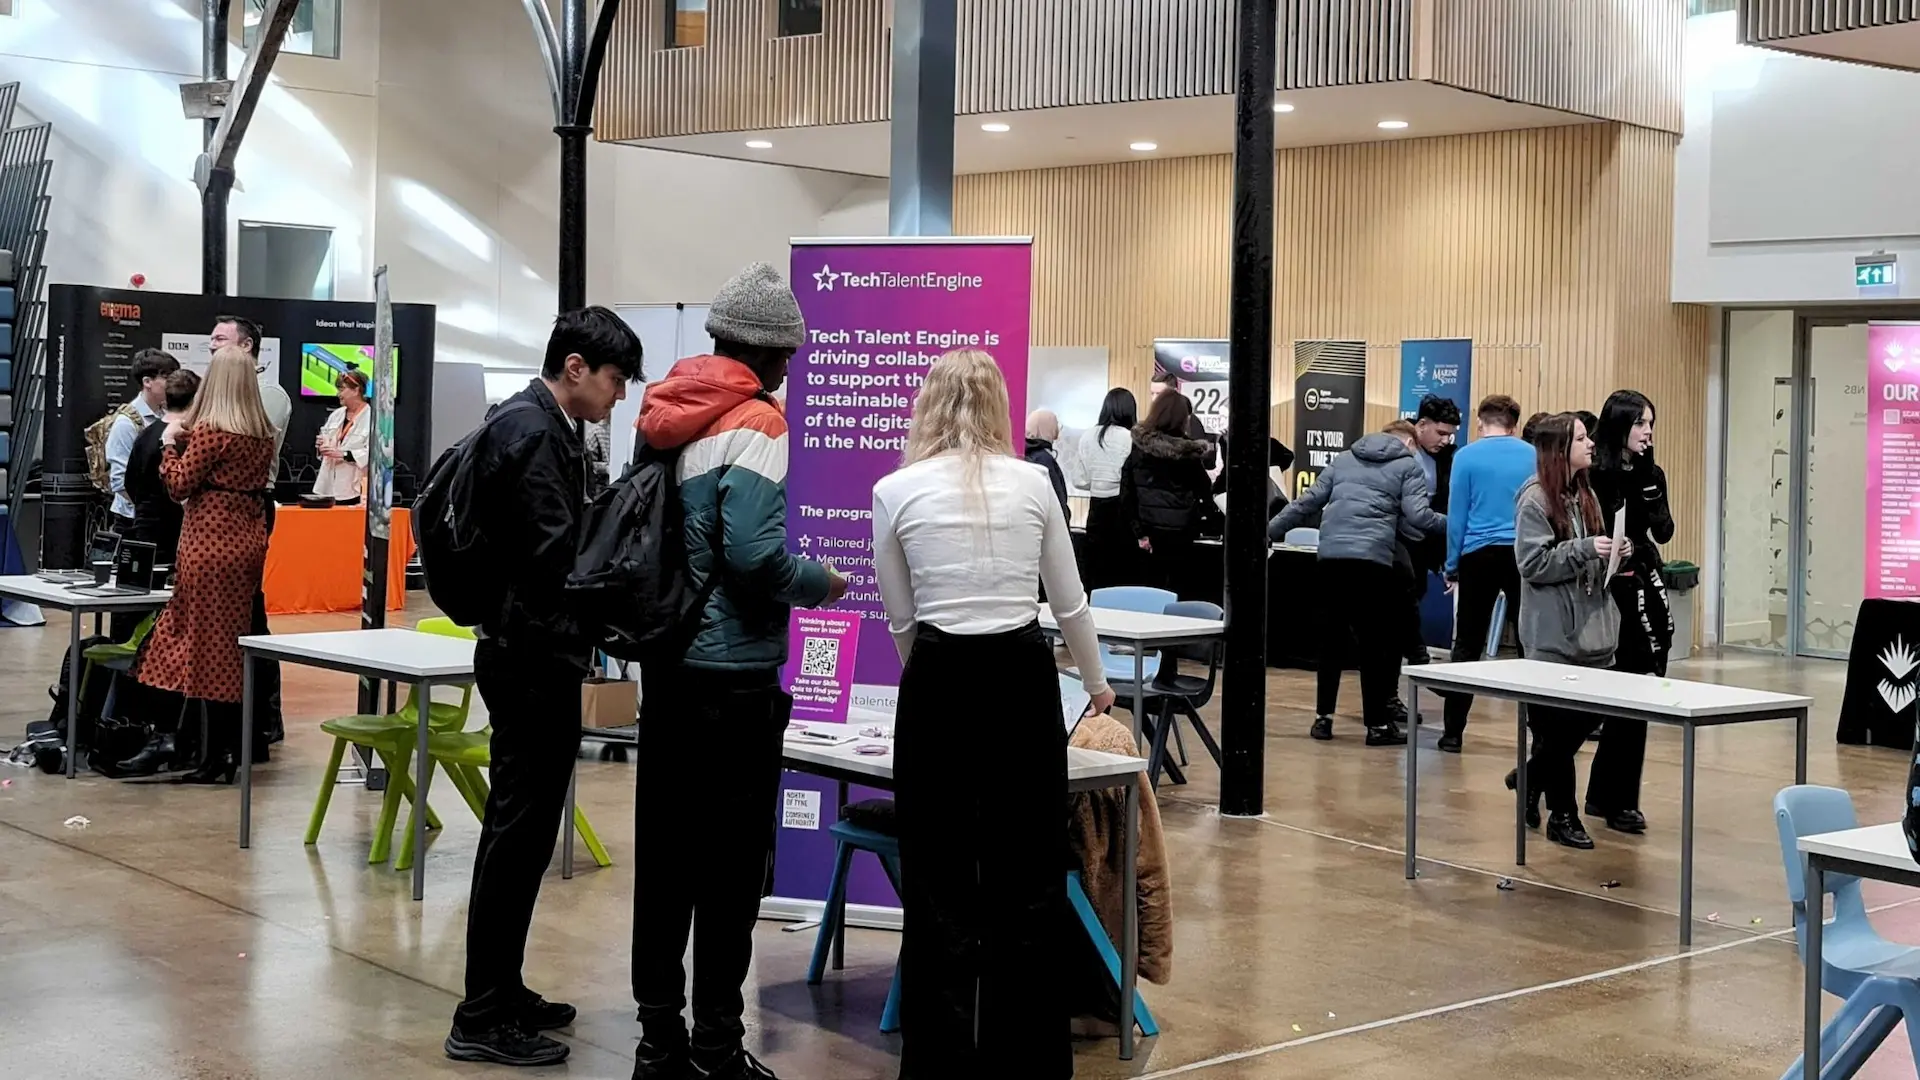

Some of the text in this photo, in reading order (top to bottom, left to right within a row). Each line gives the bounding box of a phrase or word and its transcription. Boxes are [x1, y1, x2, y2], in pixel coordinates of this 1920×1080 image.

[840, 271, 982, 292] TechTalentEngine
[100, 302, 141, 322] enigma
[316, 320, 377, 331] Ideas that inspi
[168, 342, 189, 350] BBC
[809, 329, 1000, 348] Tech Talent Engine is
[808, 350, 941, 369] driving collabo
[806, 372, 924, 389] to support th
[805, 392, 909, 408] sustainable
[1883, 383, 1919, 401] OUR
[804, 413, 913, 432] of the digita
[804, 433, 820, 448] in
[825, 434, 855, 449] the
[1306, 430, 1344, 448] IT'S YOUR
[1309, 451, 1329, 467] TIME
[800, 505, 873, 521] The progra
[817, 536, 865, 549] Tailored
[798, 617, 826, 627] Thinking
[827, 619, 843, 627] about
[829, 627, 846, 635] tech?
[794, 677, 809, 685] Take
[823, 679, 840, 687] Skills
[790, 685, 805, 693] Quiz
[827, 688, 842, 696] your
[793, 693, 814, 702] Career
[785, 811, 815, 819] COMBINED
[785, 819, 815, 827] AUTHORITY
